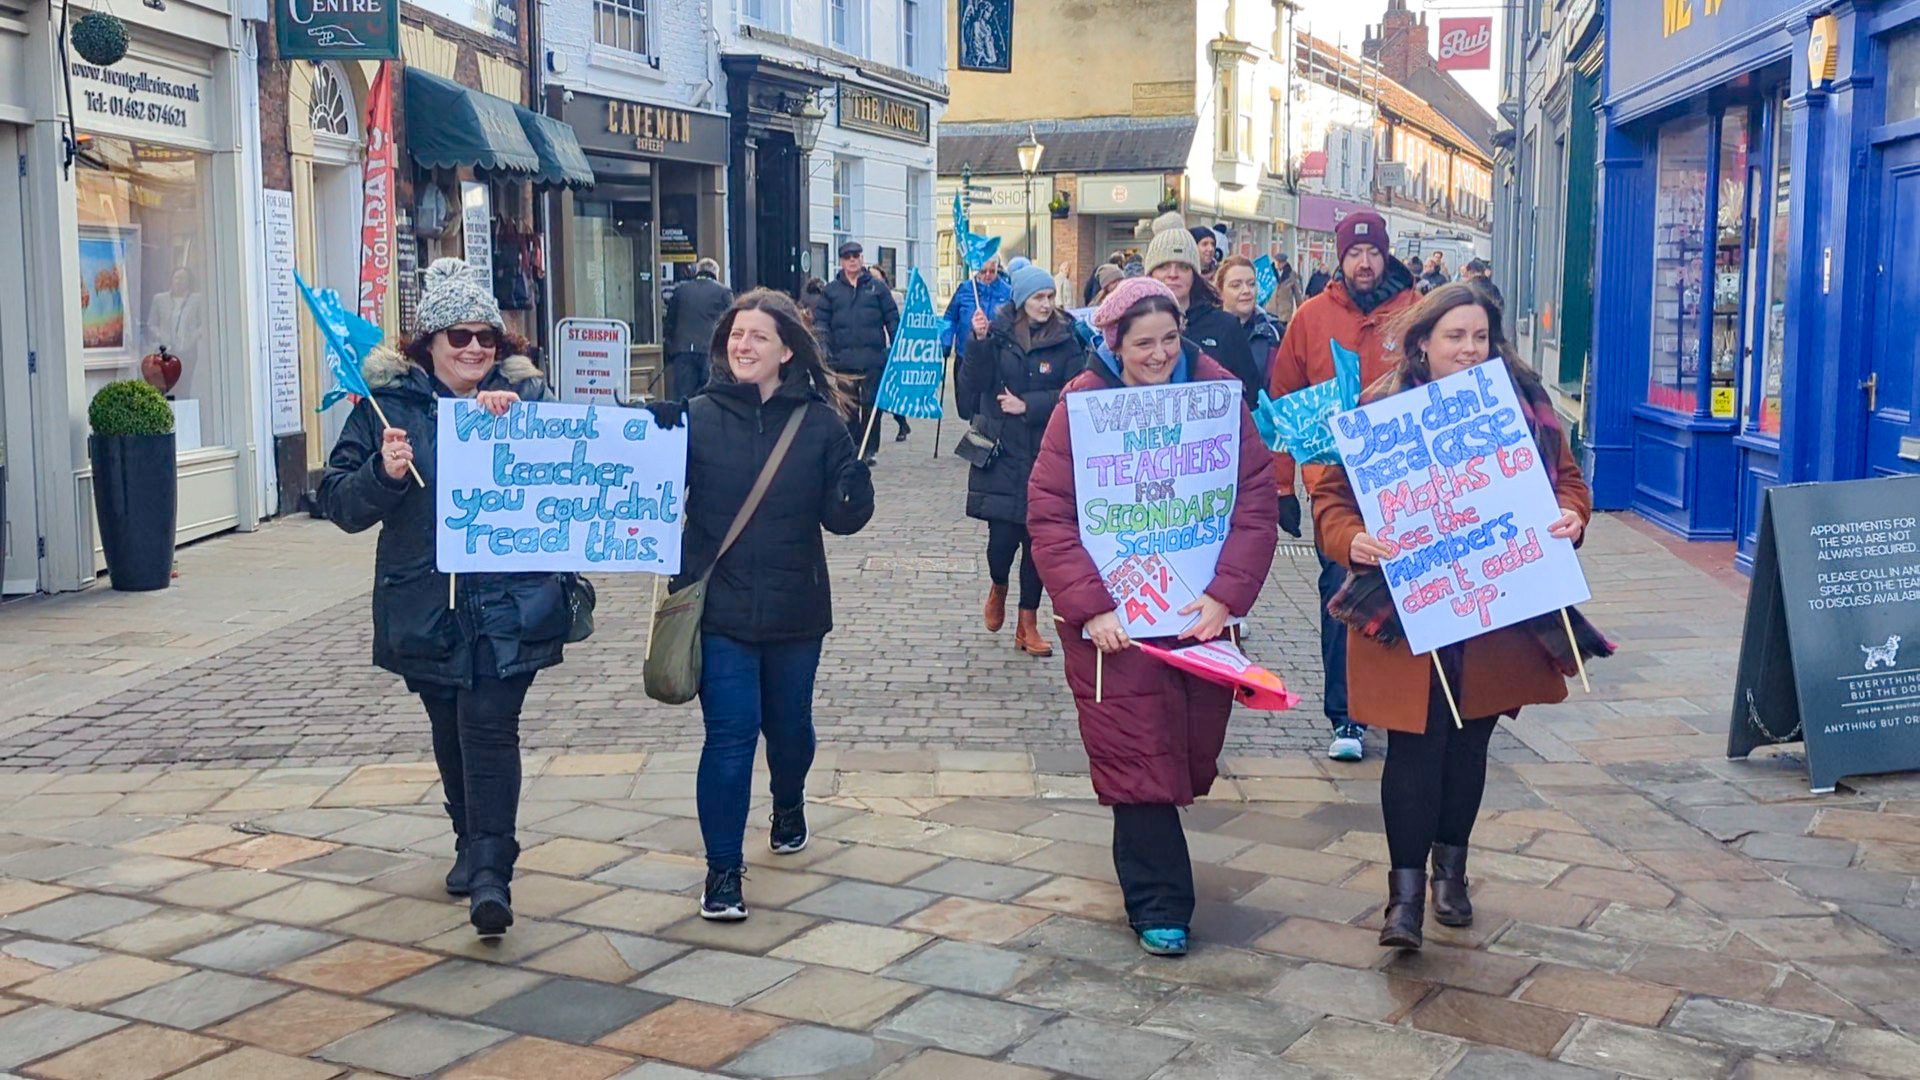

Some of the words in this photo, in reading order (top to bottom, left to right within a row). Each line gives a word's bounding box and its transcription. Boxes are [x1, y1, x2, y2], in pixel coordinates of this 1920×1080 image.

[289, 0, 382, 24] CENTRE
[1441, 25, 1490, 59] Rub
[84, 90, 107, 113] Tel:
[110, 96, 145, 120] 01482
[148, 103, 187, 127] 874621
[609, 101, 690, 144] CAVEMAN
[852, 95, 880, 122] THE
[882, 100, 920, 132] ANGEL
[568, 328, 580, 340] ST
[581, 329, 619, 342] CRISPIN
[454, 401, 600, 441] Without
[623, 418, 648, 441] a
[1087, 384, 1231, 433] WANTED
[1338, 410, 1414, 467] You
[1421, 366, 1499, 430] don't
[1124, 423, 1182, 452] NEW
[1087, 434, 1233, 487] TEACHERS
[1355, 425, 1432, 494] need
[445, 487, 525, 529] you
[536, 480, 678, 523] couldn't
[1135, 479, 1176, 502] FOR
[1377, 455, 1490, 525] Maths
[1496, 447, 1533, 478] to
[1085, 483, 1234, 536] SECONDARY
[1431, 501, 1480, 534] the
[1810, 519, 1892, 536] APPOINTMENTS
[1893, 517, 1916, 529] FOR
[466, 519, 570, 556] read
[585, 521, 664, 563] this.
[1116, 515, 1225, 559] SCHOOLS!
[1385, 512, 1518, 588] numbers
[1818, 536, 1839, 548] THE
[1841, 534, 1863, 546] SPA
[1865, 532, 1887, 543] ARE
[1888, 530, 1911, 541] NOT
[1818, 547, 1862, 560] ALWAYS
[1141, 552, 1161, 575] BY
[1402, 560, 1475, 614] don't
[1482, 527, 1543, 579] add
[1818, 571, 1858, 583] PLEASE
[1860, 568, 1887, 580] CALL
[1889, 566, 1900, 577] IN
[1125, 566, 1173, 625] 41%
[1451, 584, 1505, 627] up.
[1808, 599, 1824, 610] TO
[1826, 595, 1871, 608] DISCUSS
[1820, 584, 1854, 596] SPEAK
[1856, 582, 1872, 593] TO
[1874, 579, 1895, 591] THE
[1851, 690, 1872, 700] BUT
[1877, 687, 1897, 696] THE
[1824, 721, 1876, 734] ANYTHING
[1881, 718, 1899, 728] BUT
[1904, 715, 1920, 725] OR
